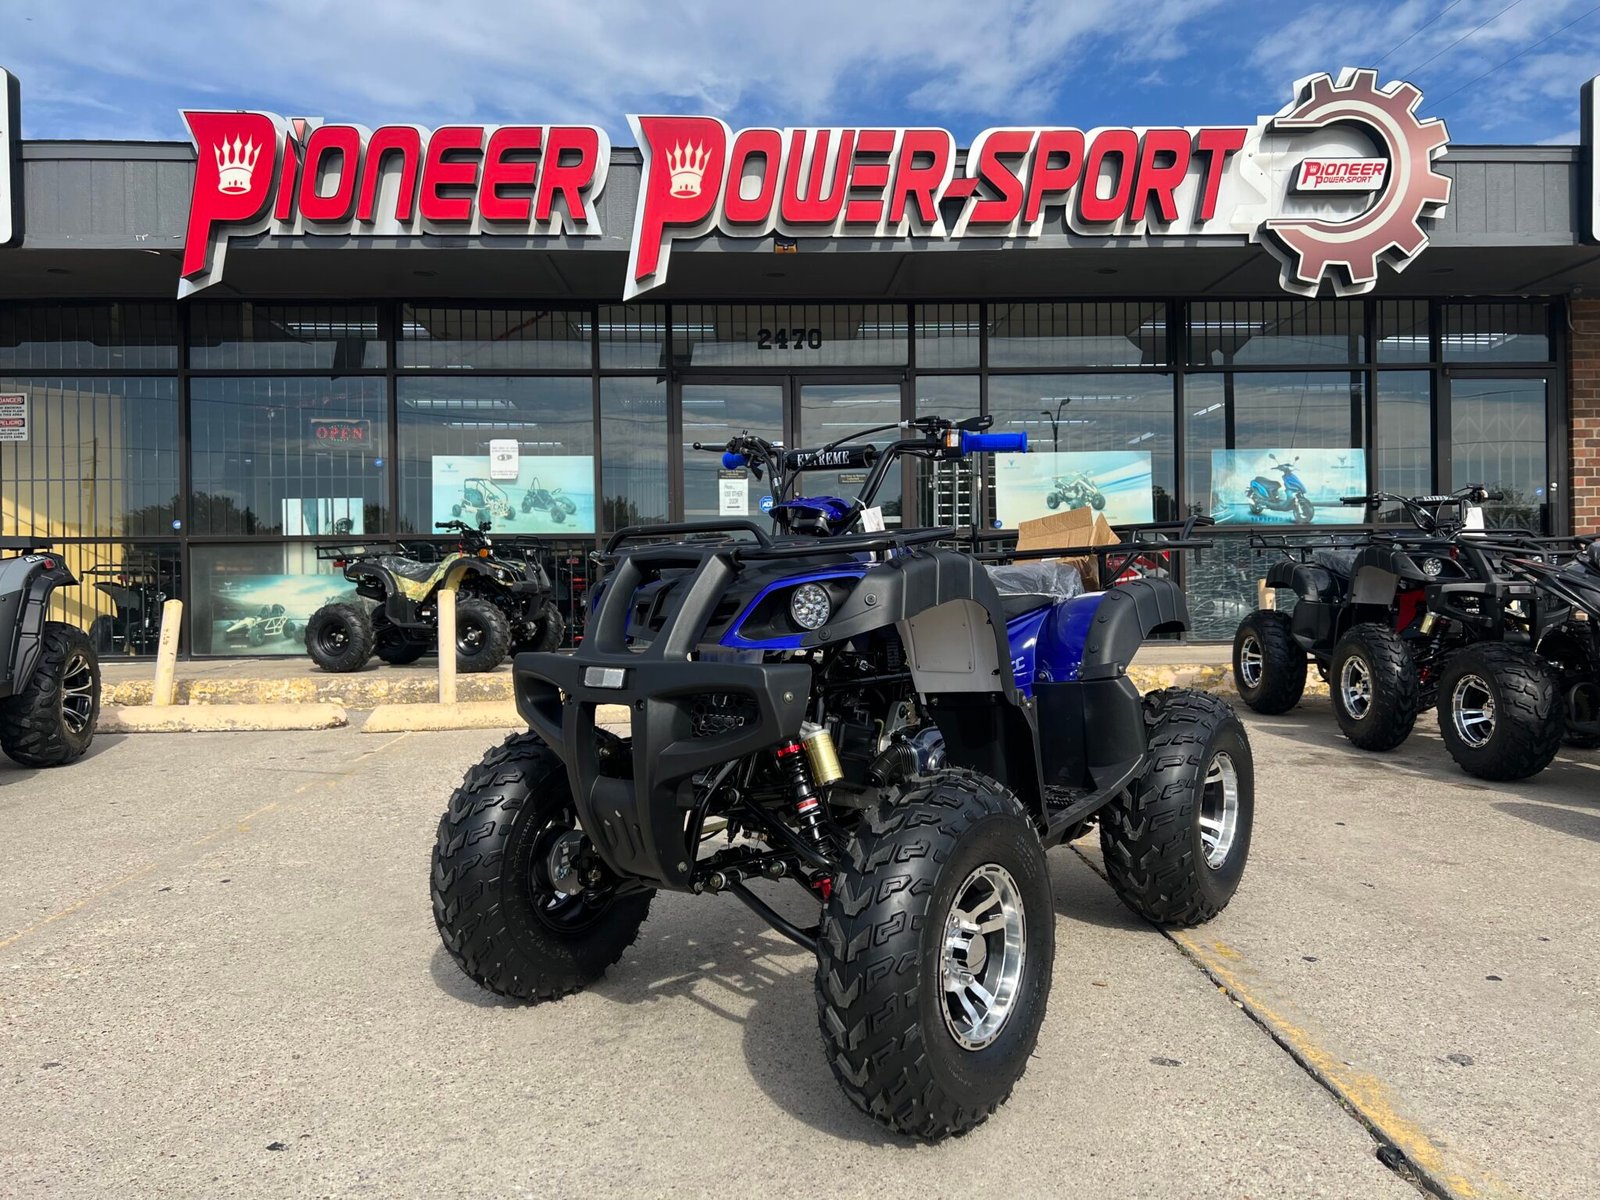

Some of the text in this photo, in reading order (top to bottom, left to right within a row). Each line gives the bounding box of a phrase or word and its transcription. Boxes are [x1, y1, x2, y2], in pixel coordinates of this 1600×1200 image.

[1314, 175, 1373, 188] POWER-SPORT
[632, 113, 1248, 283] POWER-SPORT
[757, 328, 822, 350] 2470
[316, 425, 365, 440] OPEN
[797, 451, 850, 467] EXREME
